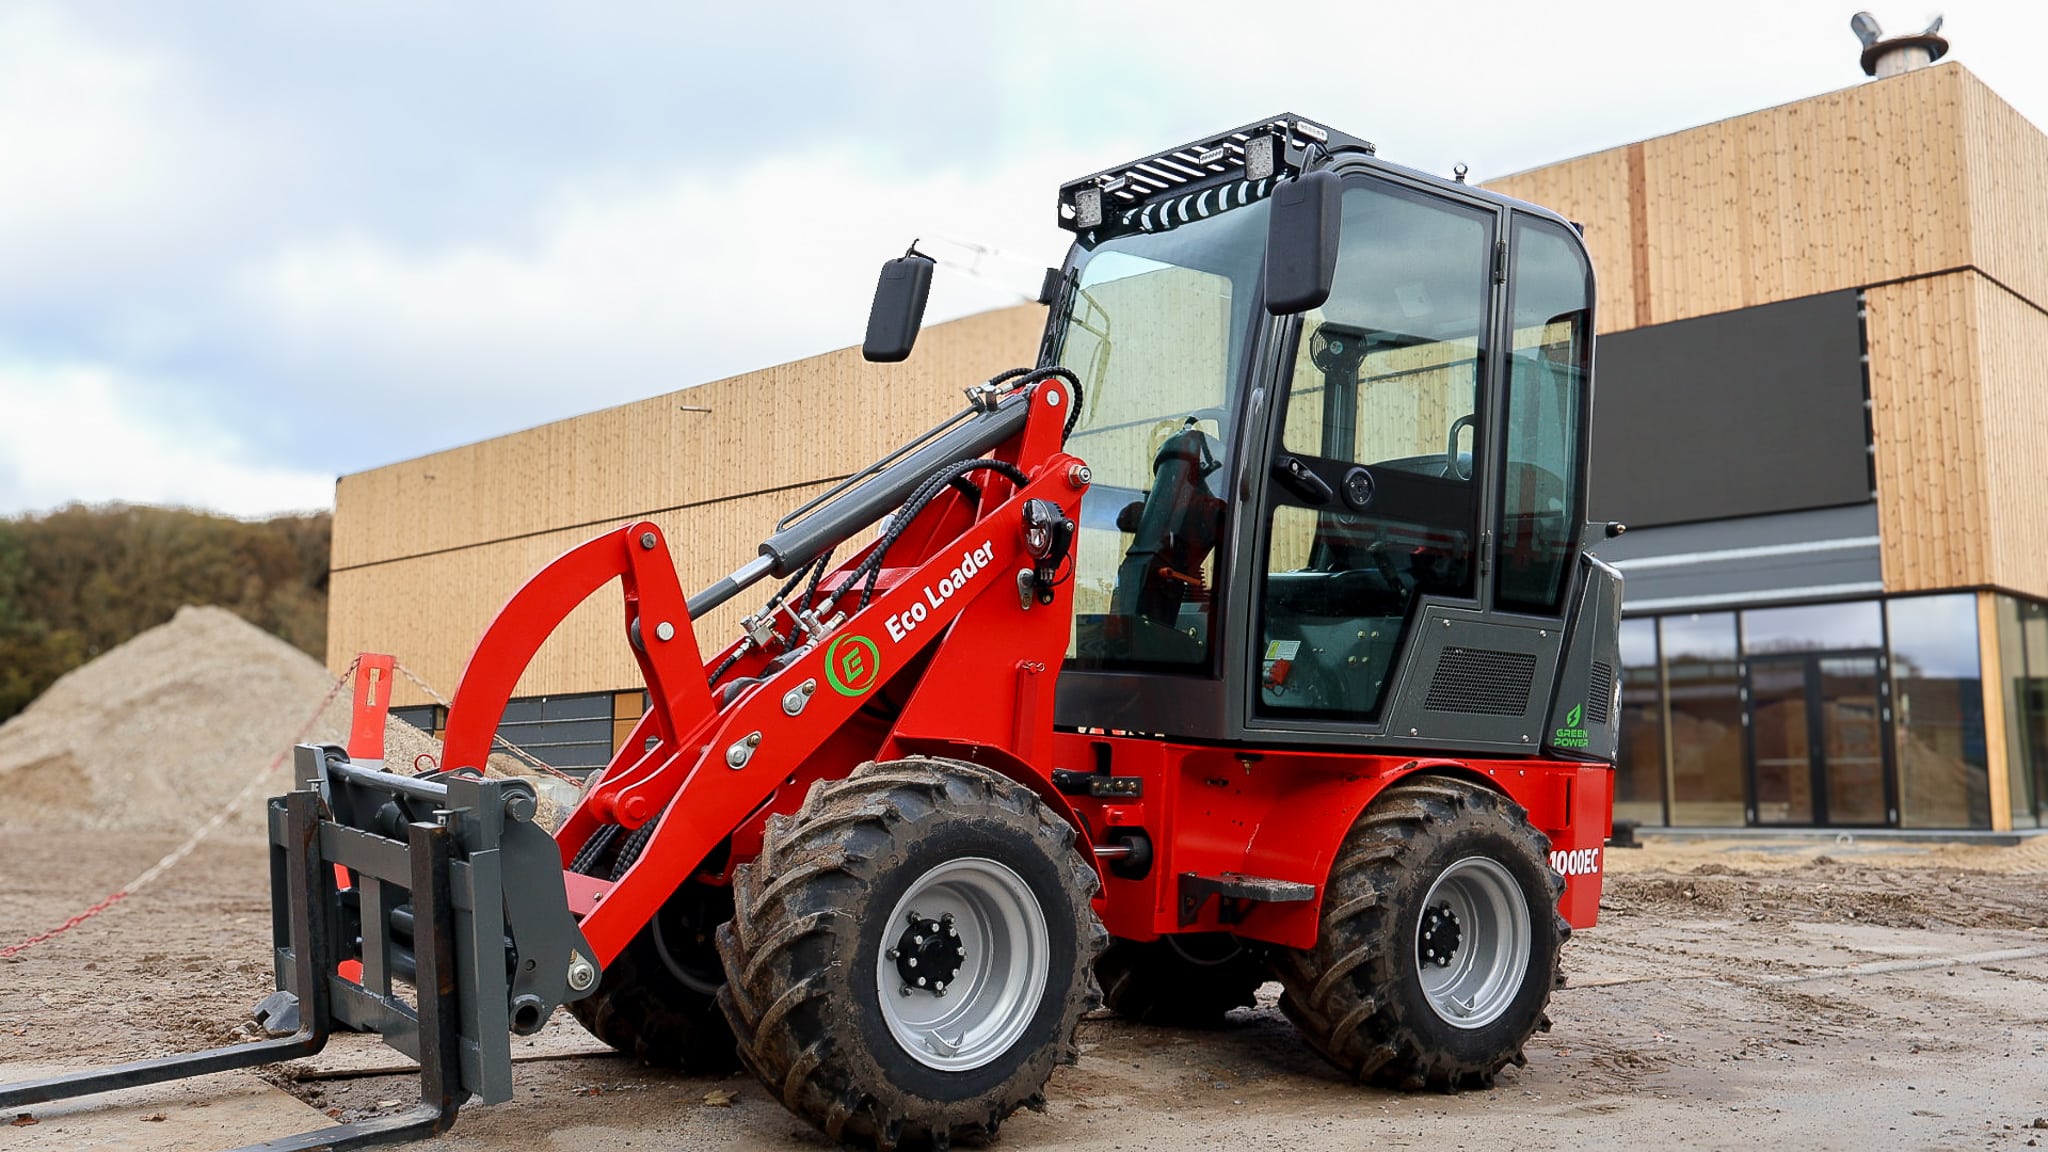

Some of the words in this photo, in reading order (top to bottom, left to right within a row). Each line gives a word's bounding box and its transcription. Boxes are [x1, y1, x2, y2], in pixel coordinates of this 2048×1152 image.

[884, 602, 927, 644] Eco
[923, 539, 995, 610] Loader
[1556, 728, 1588, 738] GREEN
[1553, 737, 1589, 748] POWER
